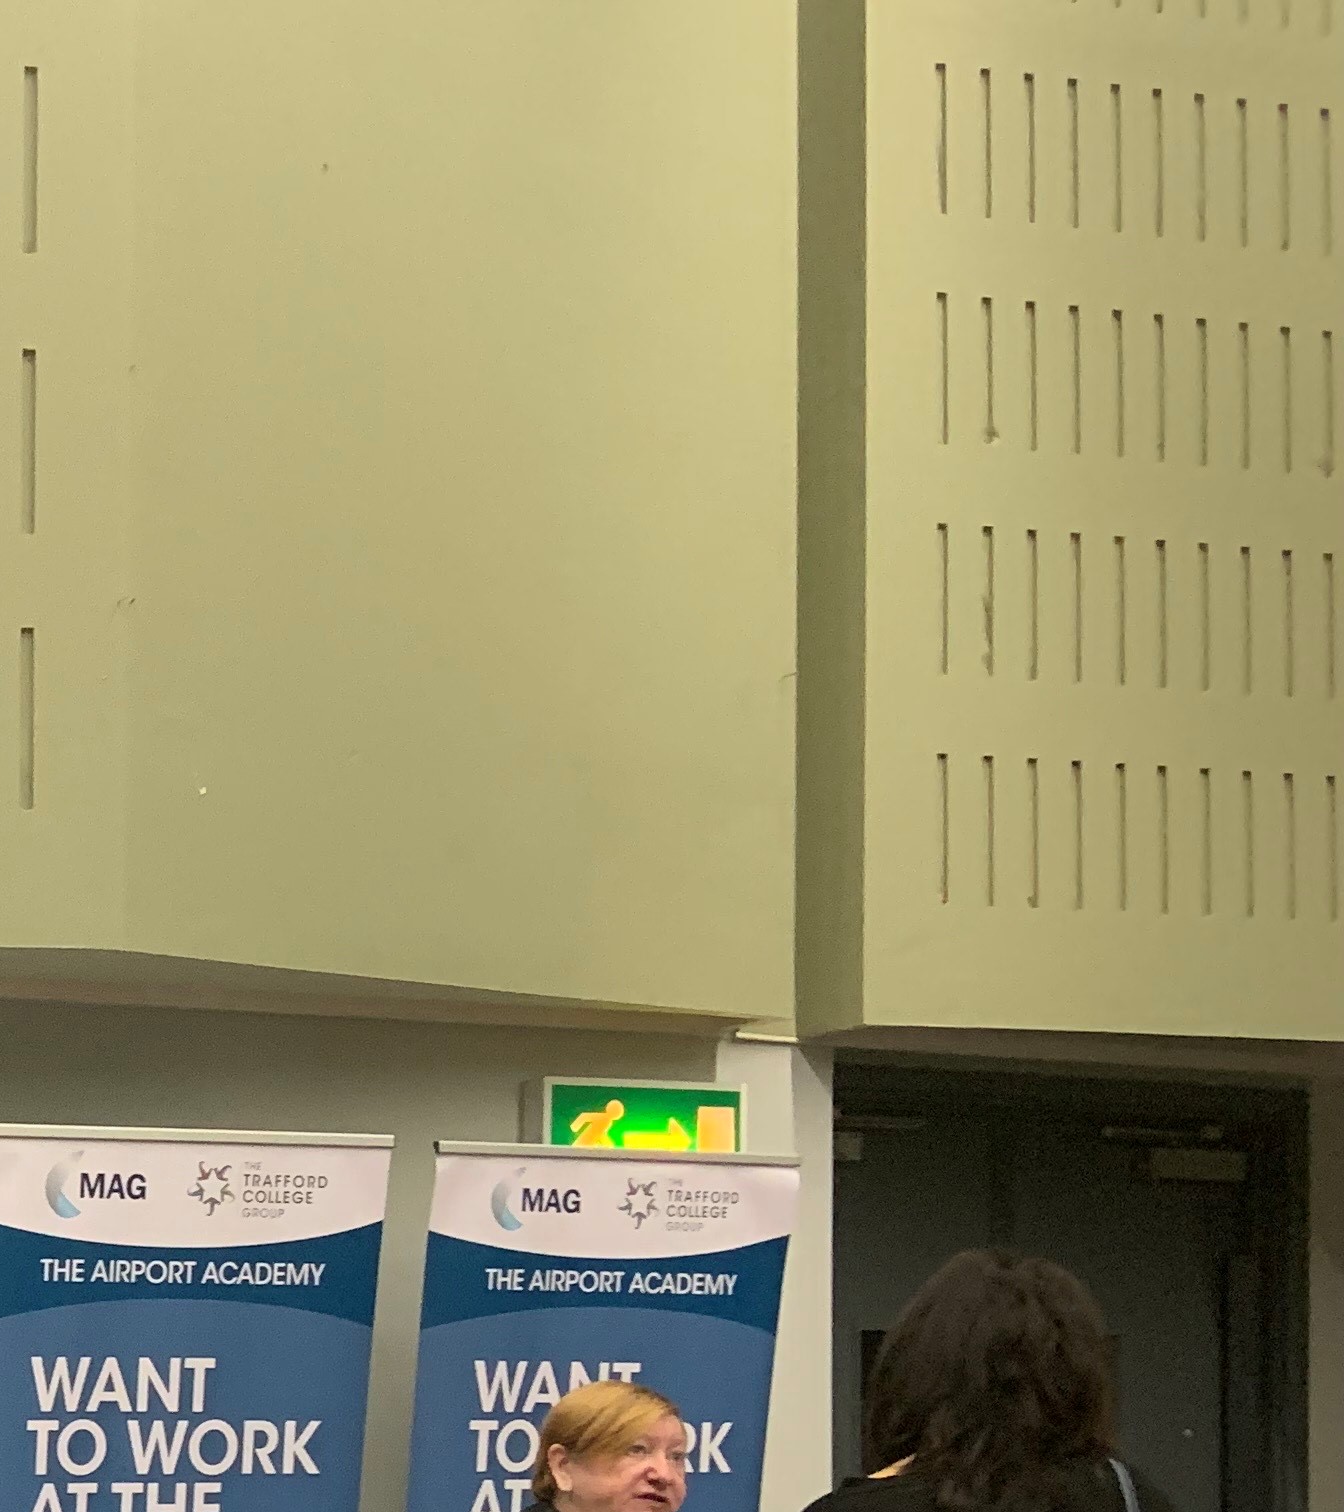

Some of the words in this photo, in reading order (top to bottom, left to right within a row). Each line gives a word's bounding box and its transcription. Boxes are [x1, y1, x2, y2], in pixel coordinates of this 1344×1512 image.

[78, 1172, 148, 1200] MAG
[242, 1173, 329, 1189] TRAFFORD
[242, 1190, 314, 1205] COLLEGE
[520, 1188, 582, 1214] MAG
[667, 1189, 740, 1204] TRAFFORD
[241, 1207, 286, 1219] GROUP
[666, 1204, 729, 1219] COLLEGE
[40, 1258, 86, 1283] THE
[90, 1259, 198, 1285] AIRPORT
[201, 1261, 327, 1287] ACADEMY
[485, 1268, 524, 1292] THE
[528, 1269, 625, 1294] AIRPORT
[628, 1271, 738, 1297] ACADEMY
[29, 1356, 218, 1414] WANT
[26, 1418, 108, 1478] TO
[127, 1420, 322, 1478] WORK
[469, 1418, 541, 1473] TO
